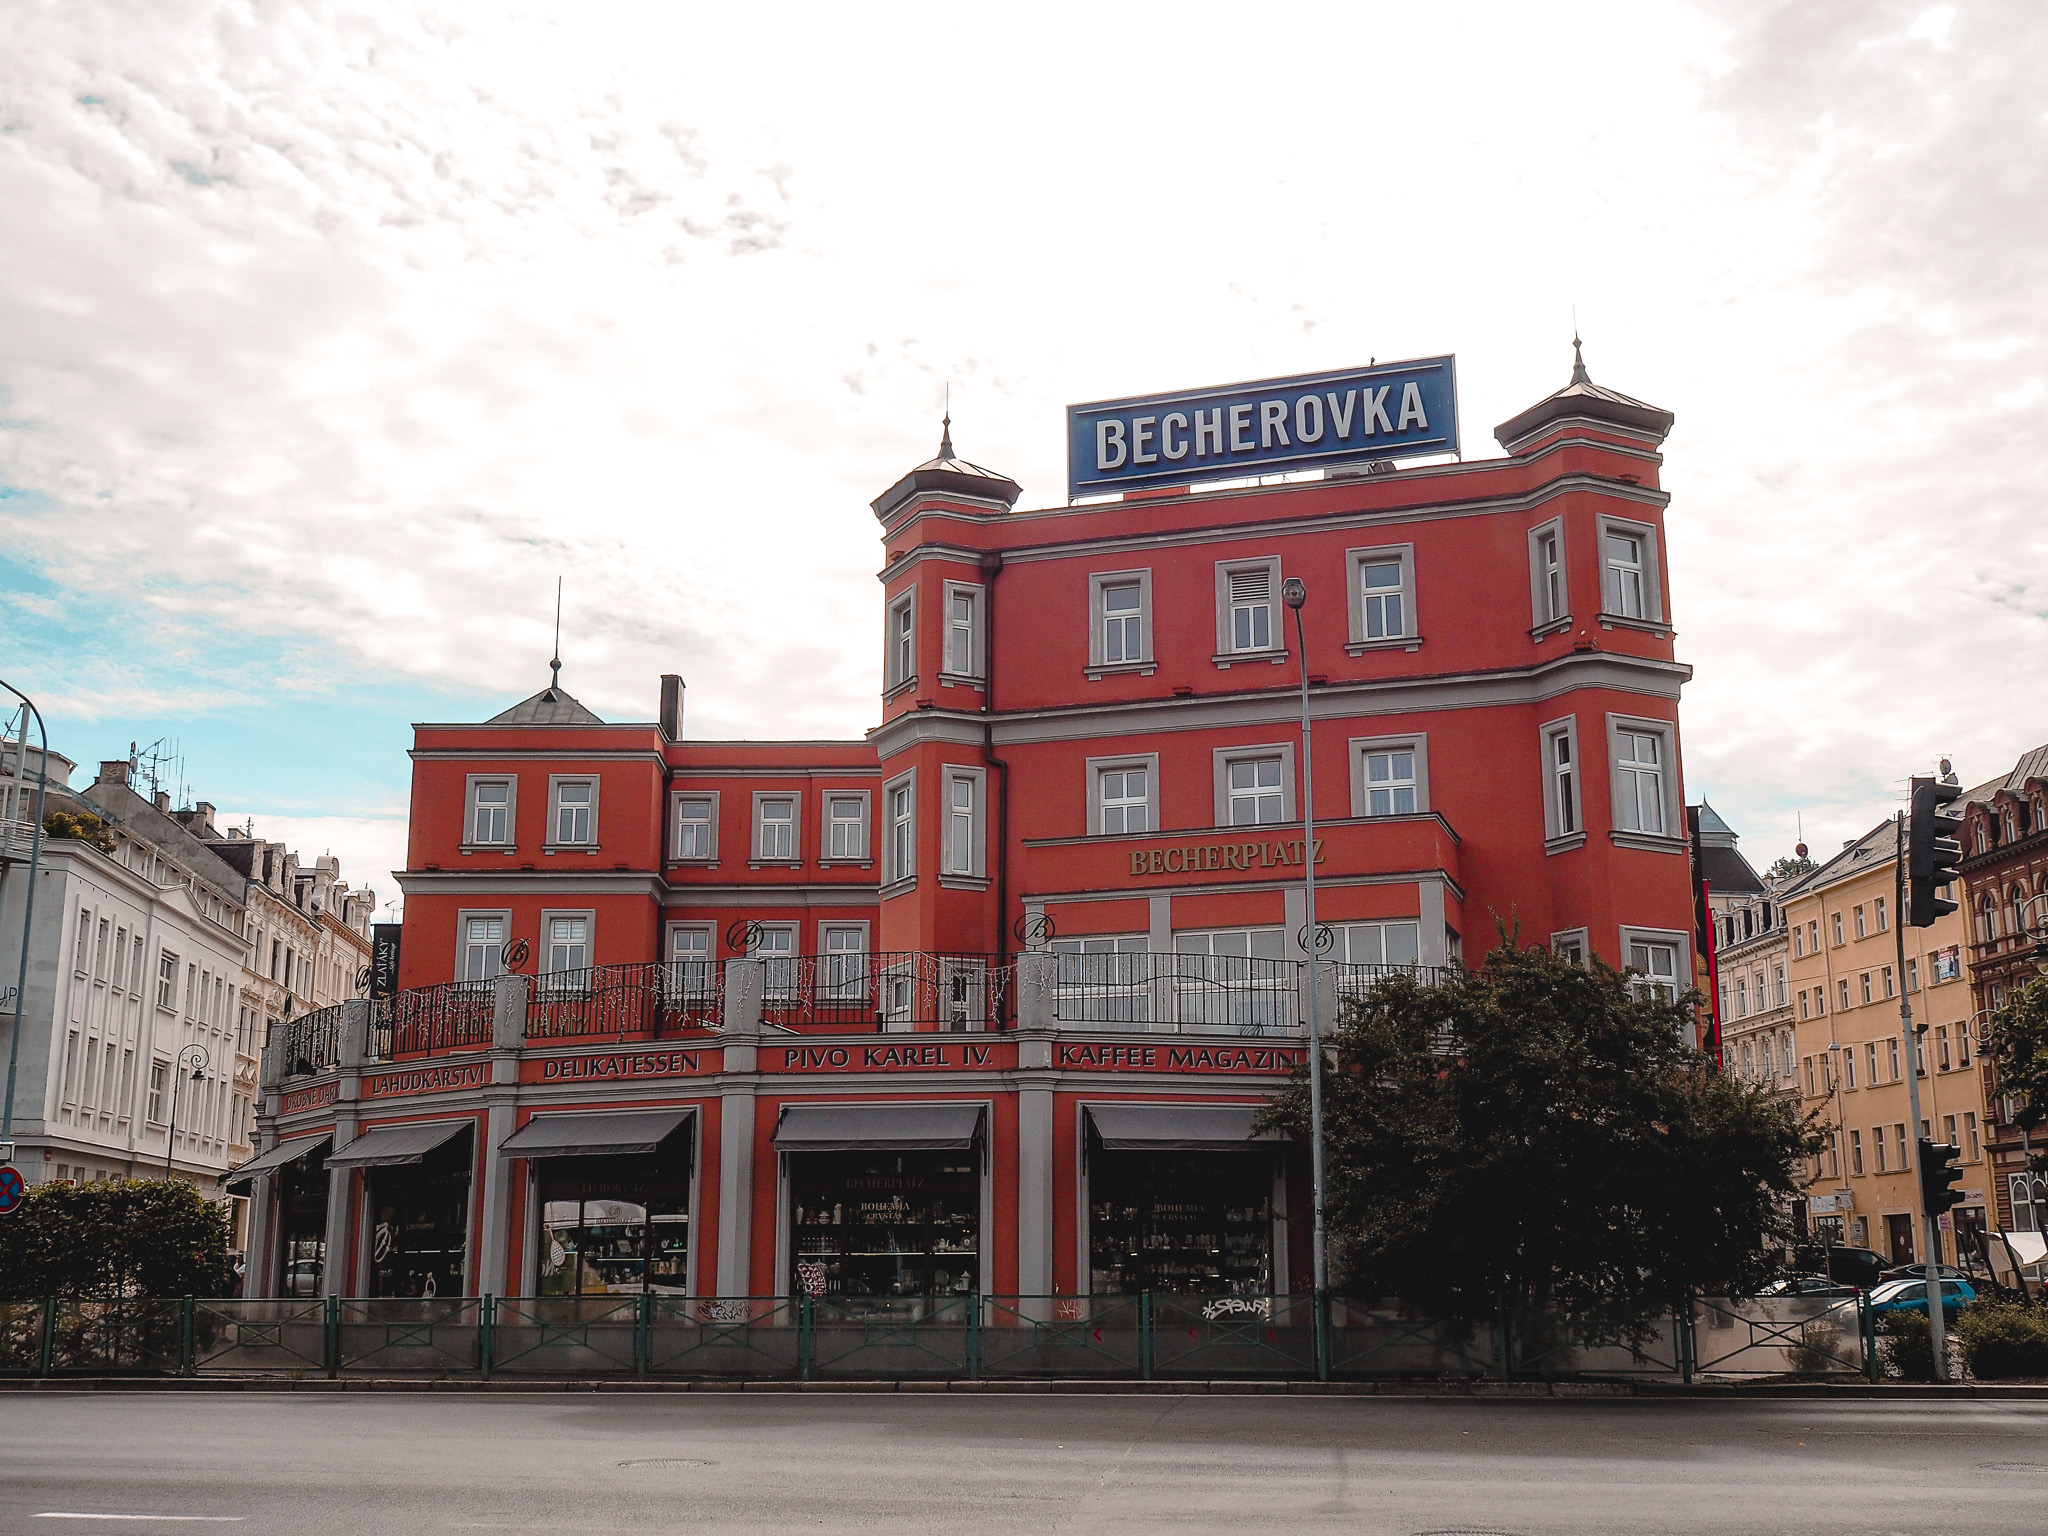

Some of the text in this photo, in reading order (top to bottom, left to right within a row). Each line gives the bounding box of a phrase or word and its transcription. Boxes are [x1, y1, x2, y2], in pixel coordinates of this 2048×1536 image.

[1095, 381, 1429, 471] BECHEROVKA
[1128, 838, 1325, 876] BECHERPLATZ
[543, 1052, 700, 1080] DELIKATESSEN
[784, 1046, 993, 1068] PIVO KAREL IV.
[1059, 1045, 1298, 1070] KAFFEE MAGAZIN
[860, 1202, 911, 1212] BOHEMIA
